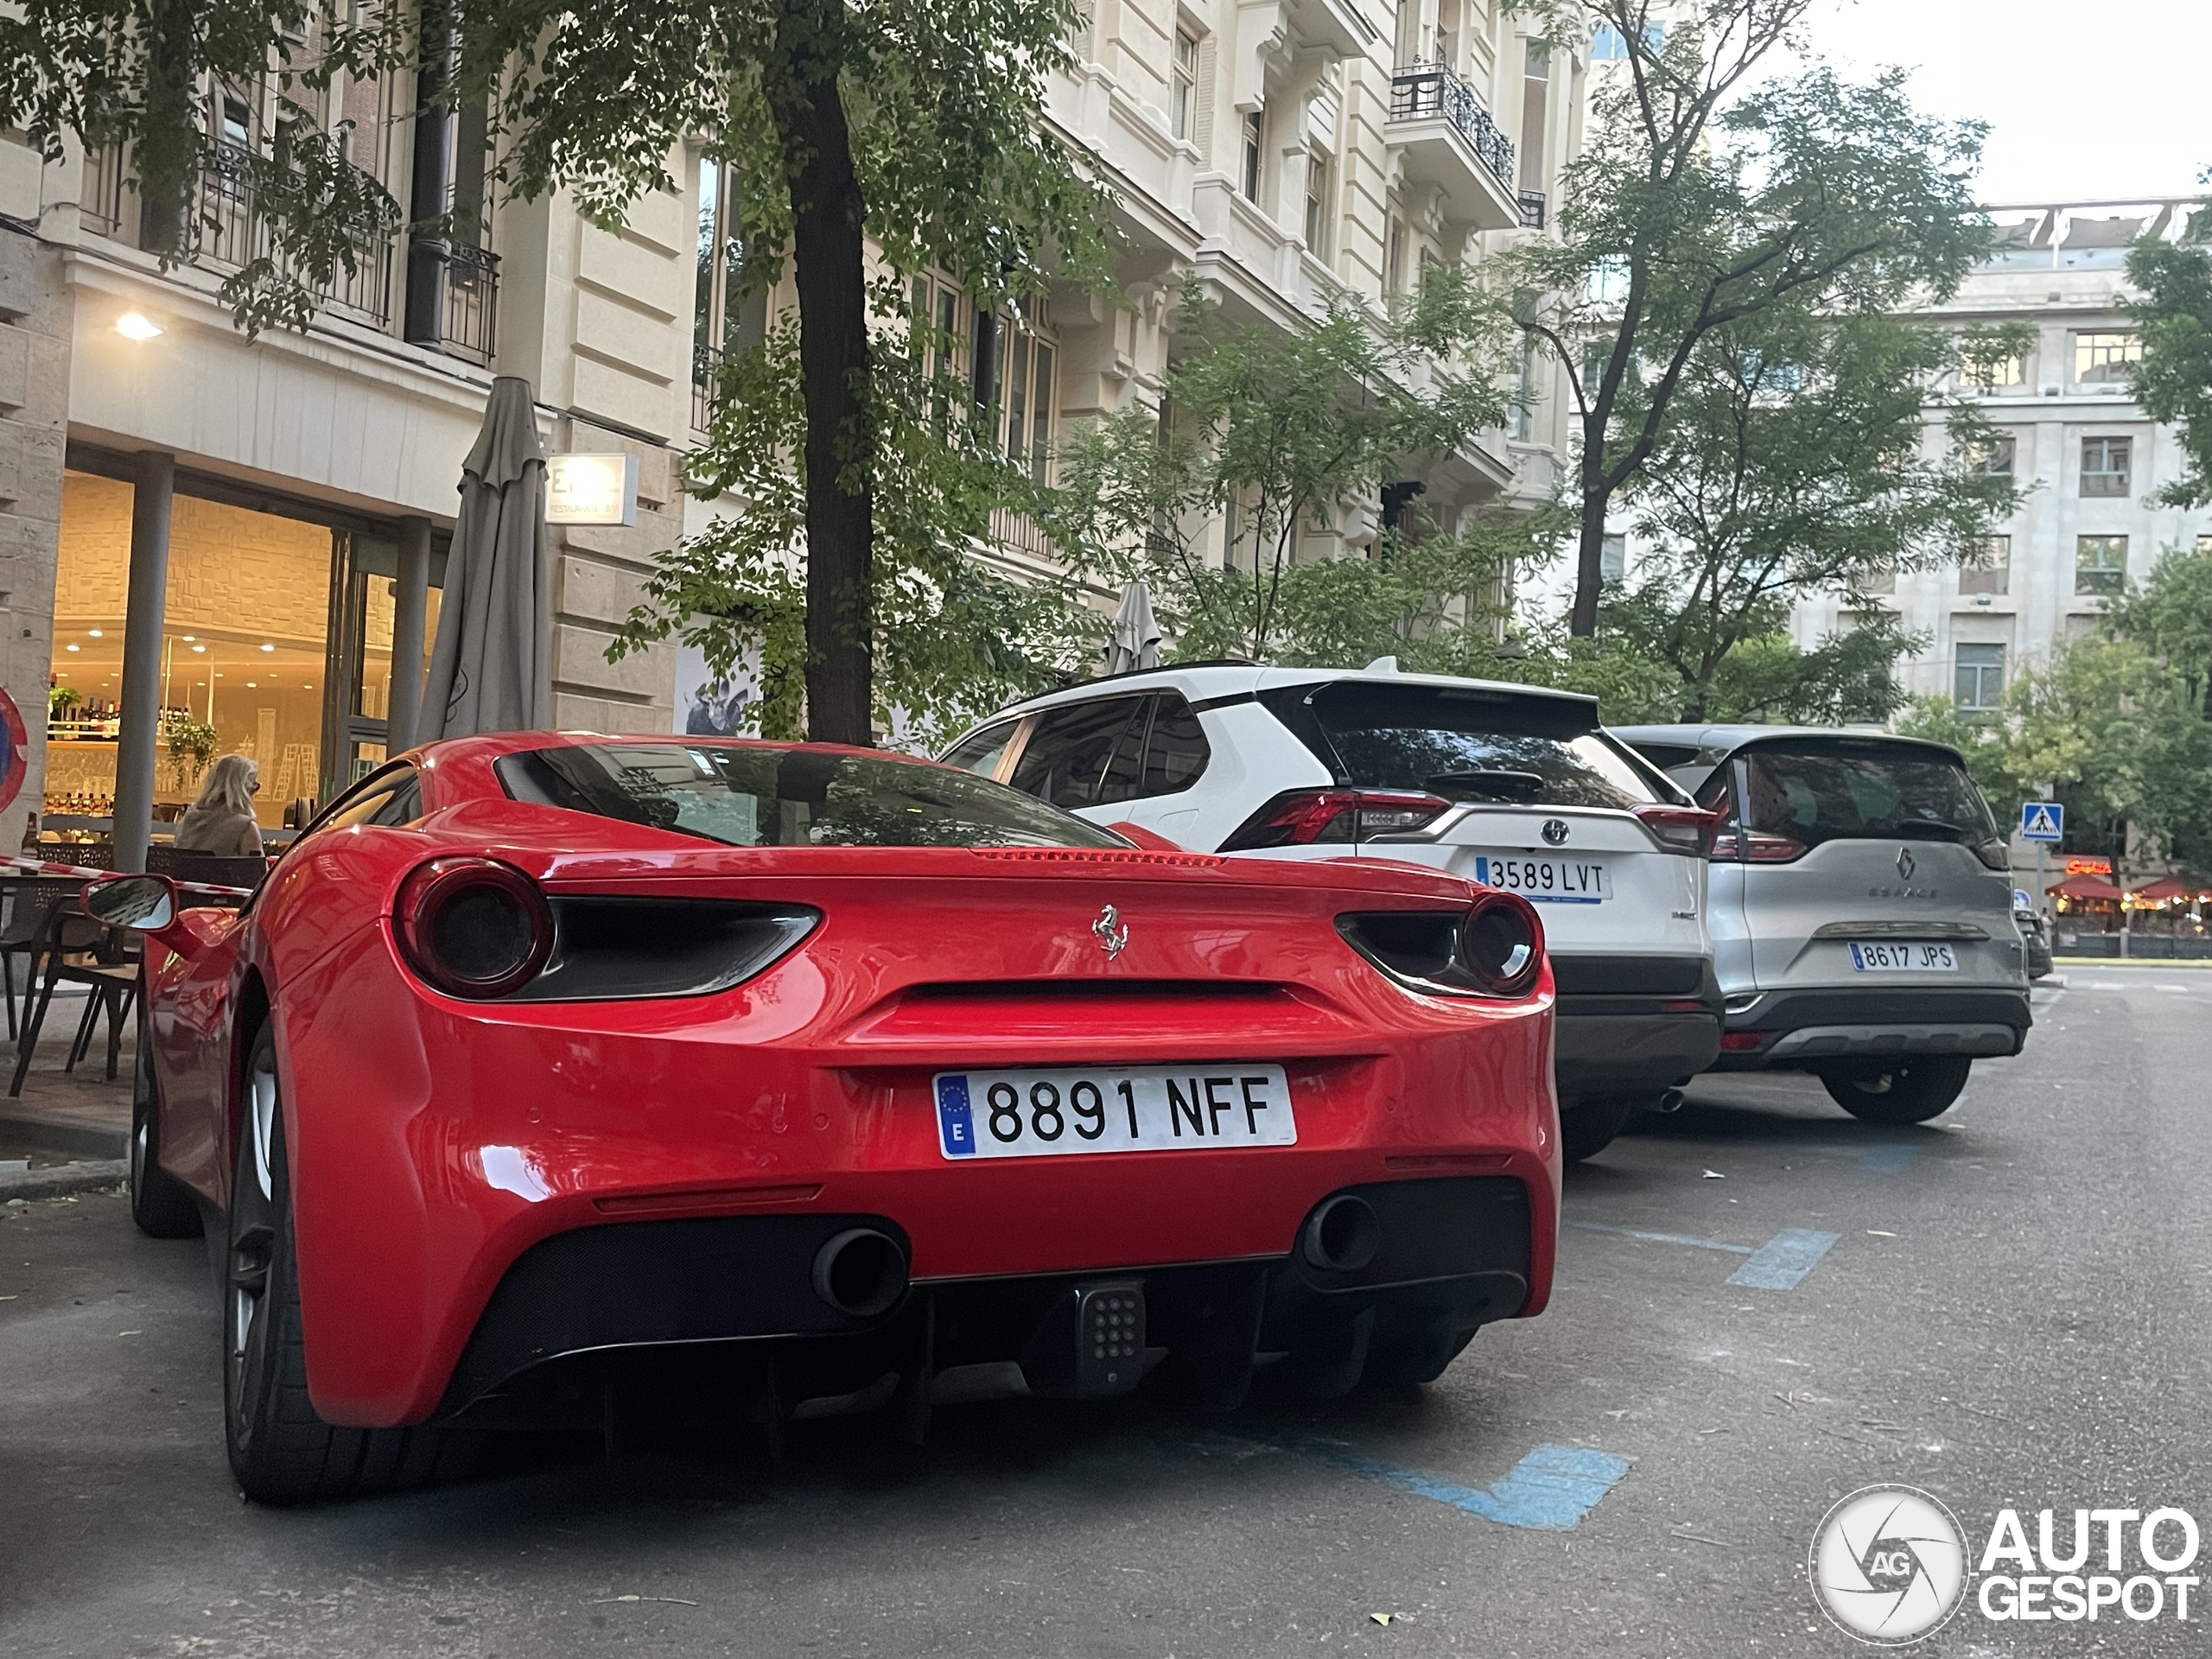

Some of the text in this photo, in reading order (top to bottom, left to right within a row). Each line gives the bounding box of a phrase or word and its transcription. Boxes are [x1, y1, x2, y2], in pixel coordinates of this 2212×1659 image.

[1491, 861, 1603, 893] 3589 LVT
[1864, 946, 1952, 967] 8617 JPS
[987, 1076, 1269, 1143] 8891 NFF
[952, 1123, 964, 1141] E
